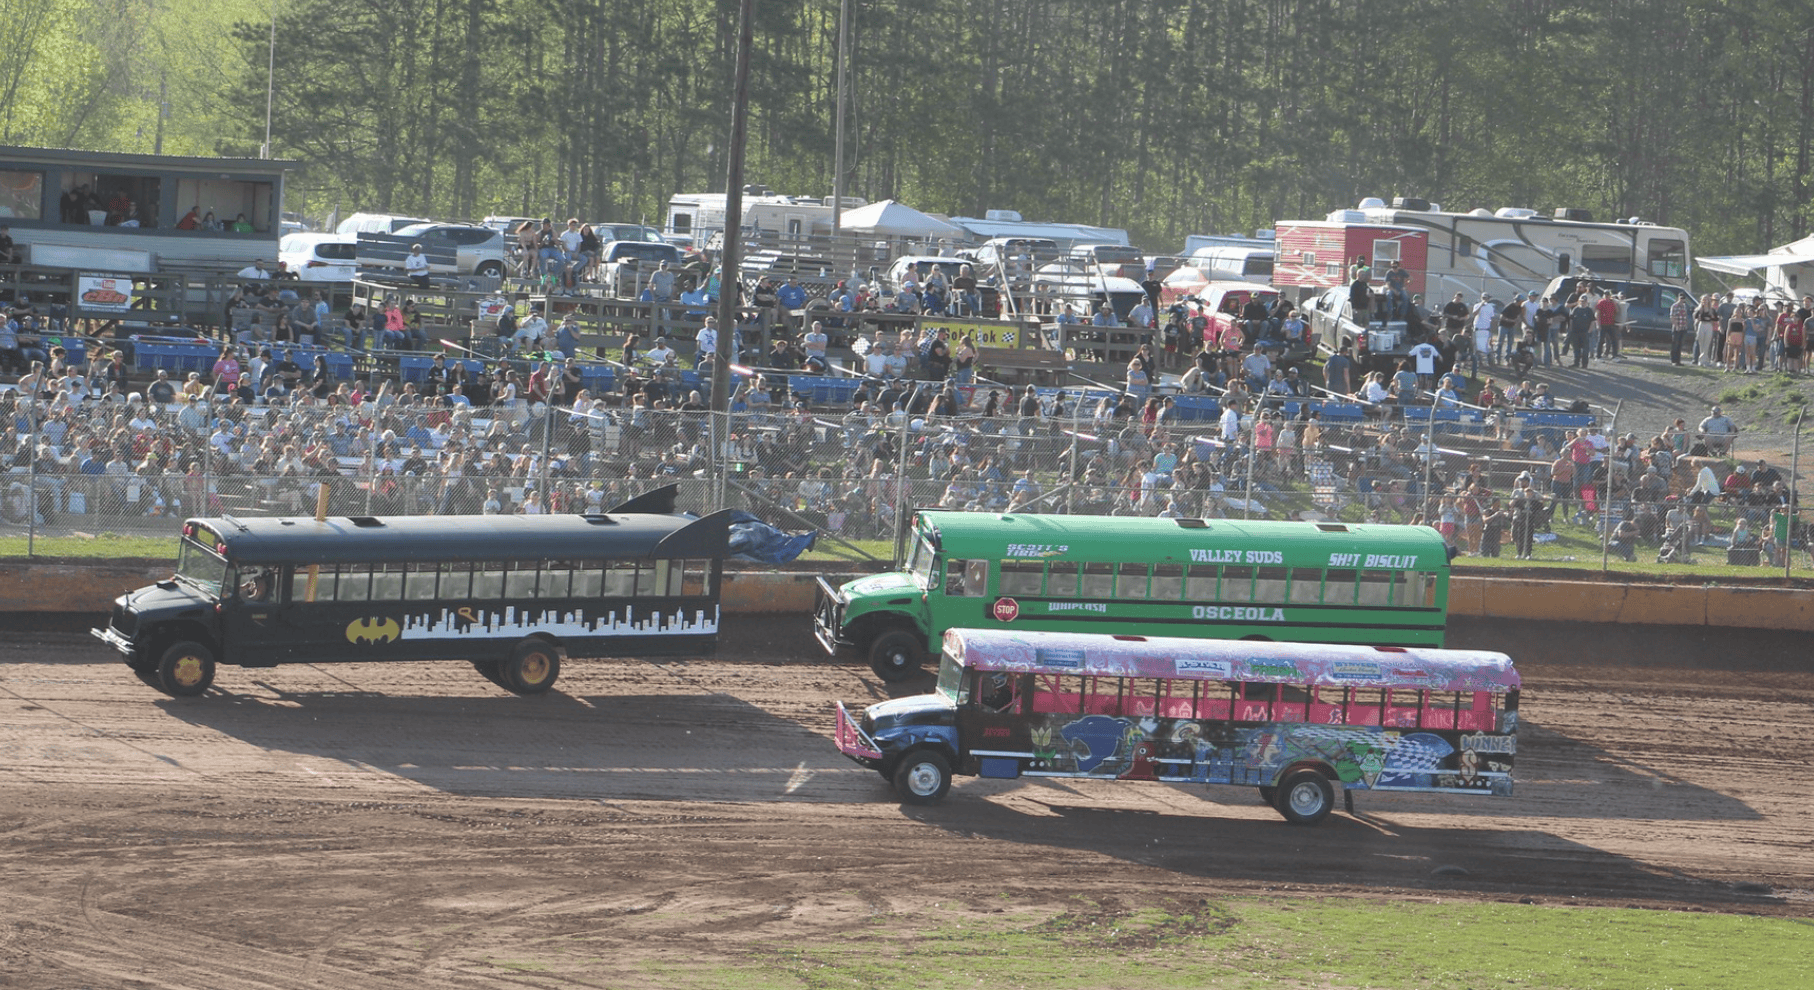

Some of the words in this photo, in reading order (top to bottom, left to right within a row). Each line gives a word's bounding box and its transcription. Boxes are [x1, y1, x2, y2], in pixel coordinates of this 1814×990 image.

[1189, 549, 1243, 563] VALLEY
[1246, 550, 1284, 564] SUDS
[1328, 552, 1361, 567] SH!T
[1363, 553, 1419, 569] BISCUIT
[996, 604, 1016, 615] STOP
[1048, 602, 1107, 612] WHIPLASH
[1192, 605, 1286, 621] OSCEOLA
